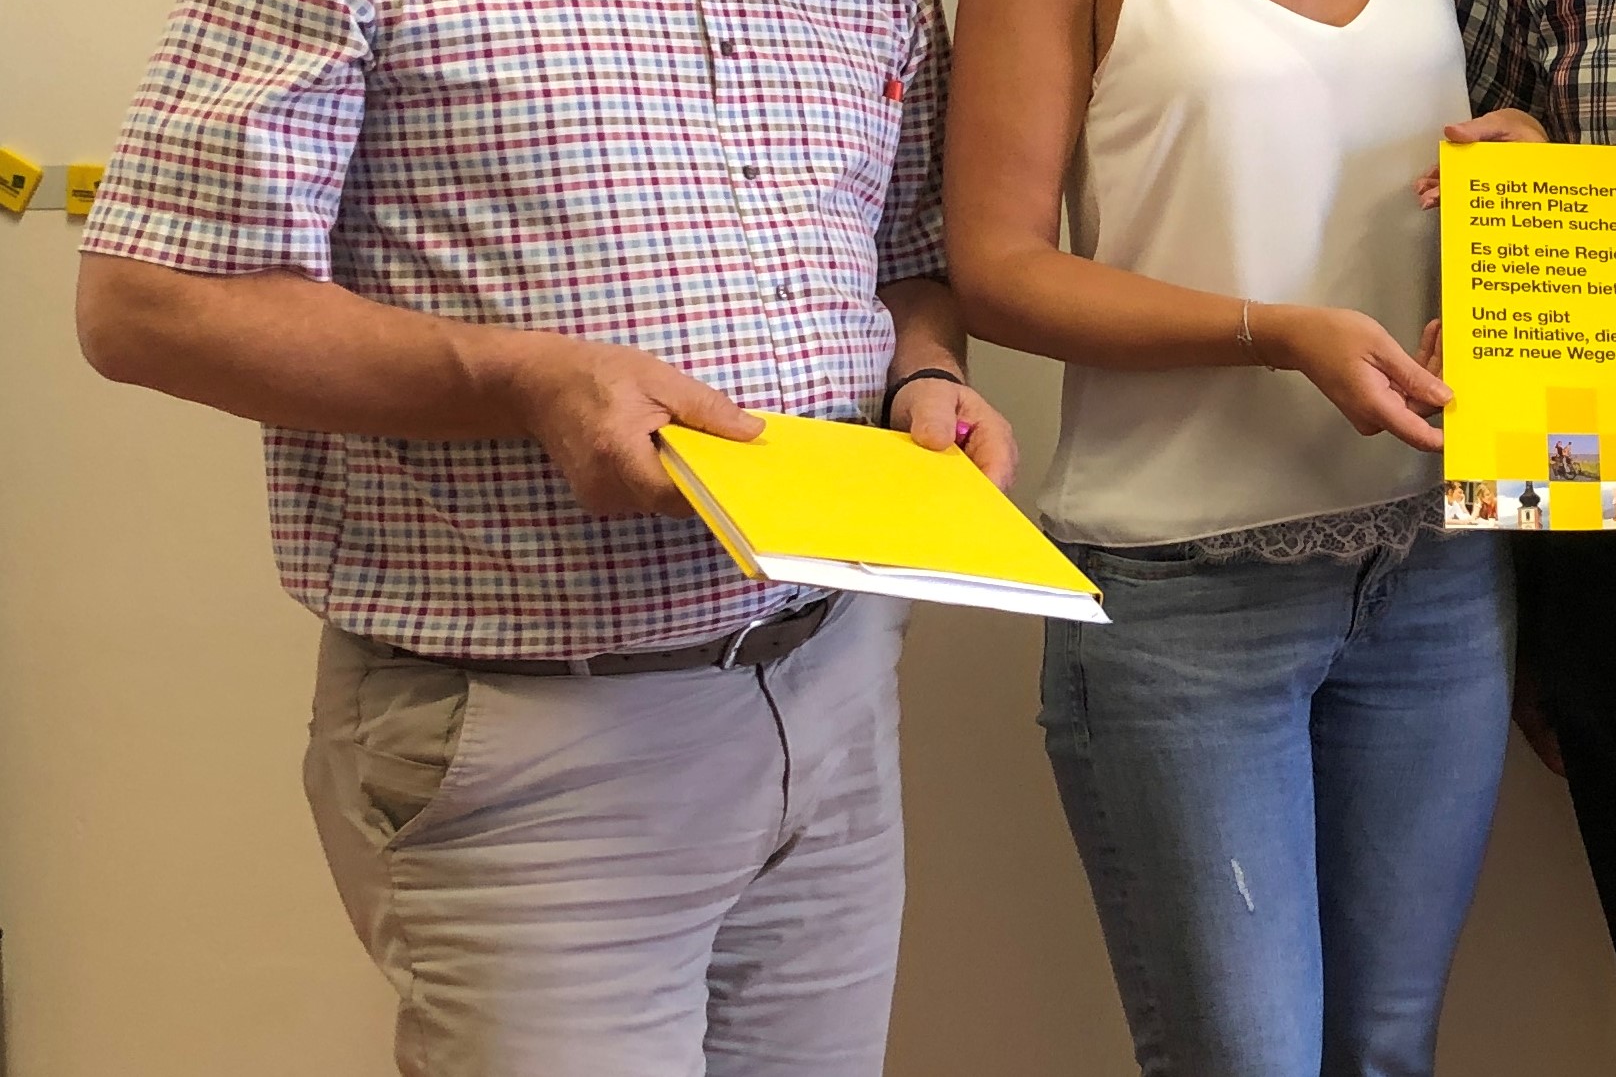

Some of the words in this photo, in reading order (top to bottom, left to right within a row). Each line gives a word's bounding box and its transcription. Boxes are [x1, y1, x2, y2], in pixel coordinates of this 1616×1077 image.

[1470, 179, 1490, 193] Es
[1496, 180, 1528, 196] gibt
[1469, 196, 1494, 210] die
[1501, 198, 1541, 212] ihren
[1548, 199, 1589, 213] Platz
[1470, 216, 1505, 228] zum
[1512, 215, 1563, 230] Leben
[1471, 242, 1492, 256] Es
[1497, 243, 1529, 258] gibt
[1534, 244, 1569, 259] eine
[1471, 260, 1496, 274] die
[1501, 261, 1540, 276] viele
[1545, 264, 1587, 276] neue
[1471, 277, 1582, 295] Perspektiven
[1472, 306, 1507, 322] Und
[1512, 310, 1532, 323] es
[1538, 309, 1570, 325] gibt
[1472, 325, 1508, 340] eine
[1513, 326, 1590, 344] Initiative,
[1472, 345, 1514, 361] ganz
[1519, 347, 1562, 360] neue
[1567, 346, 1616, 363] Wege
